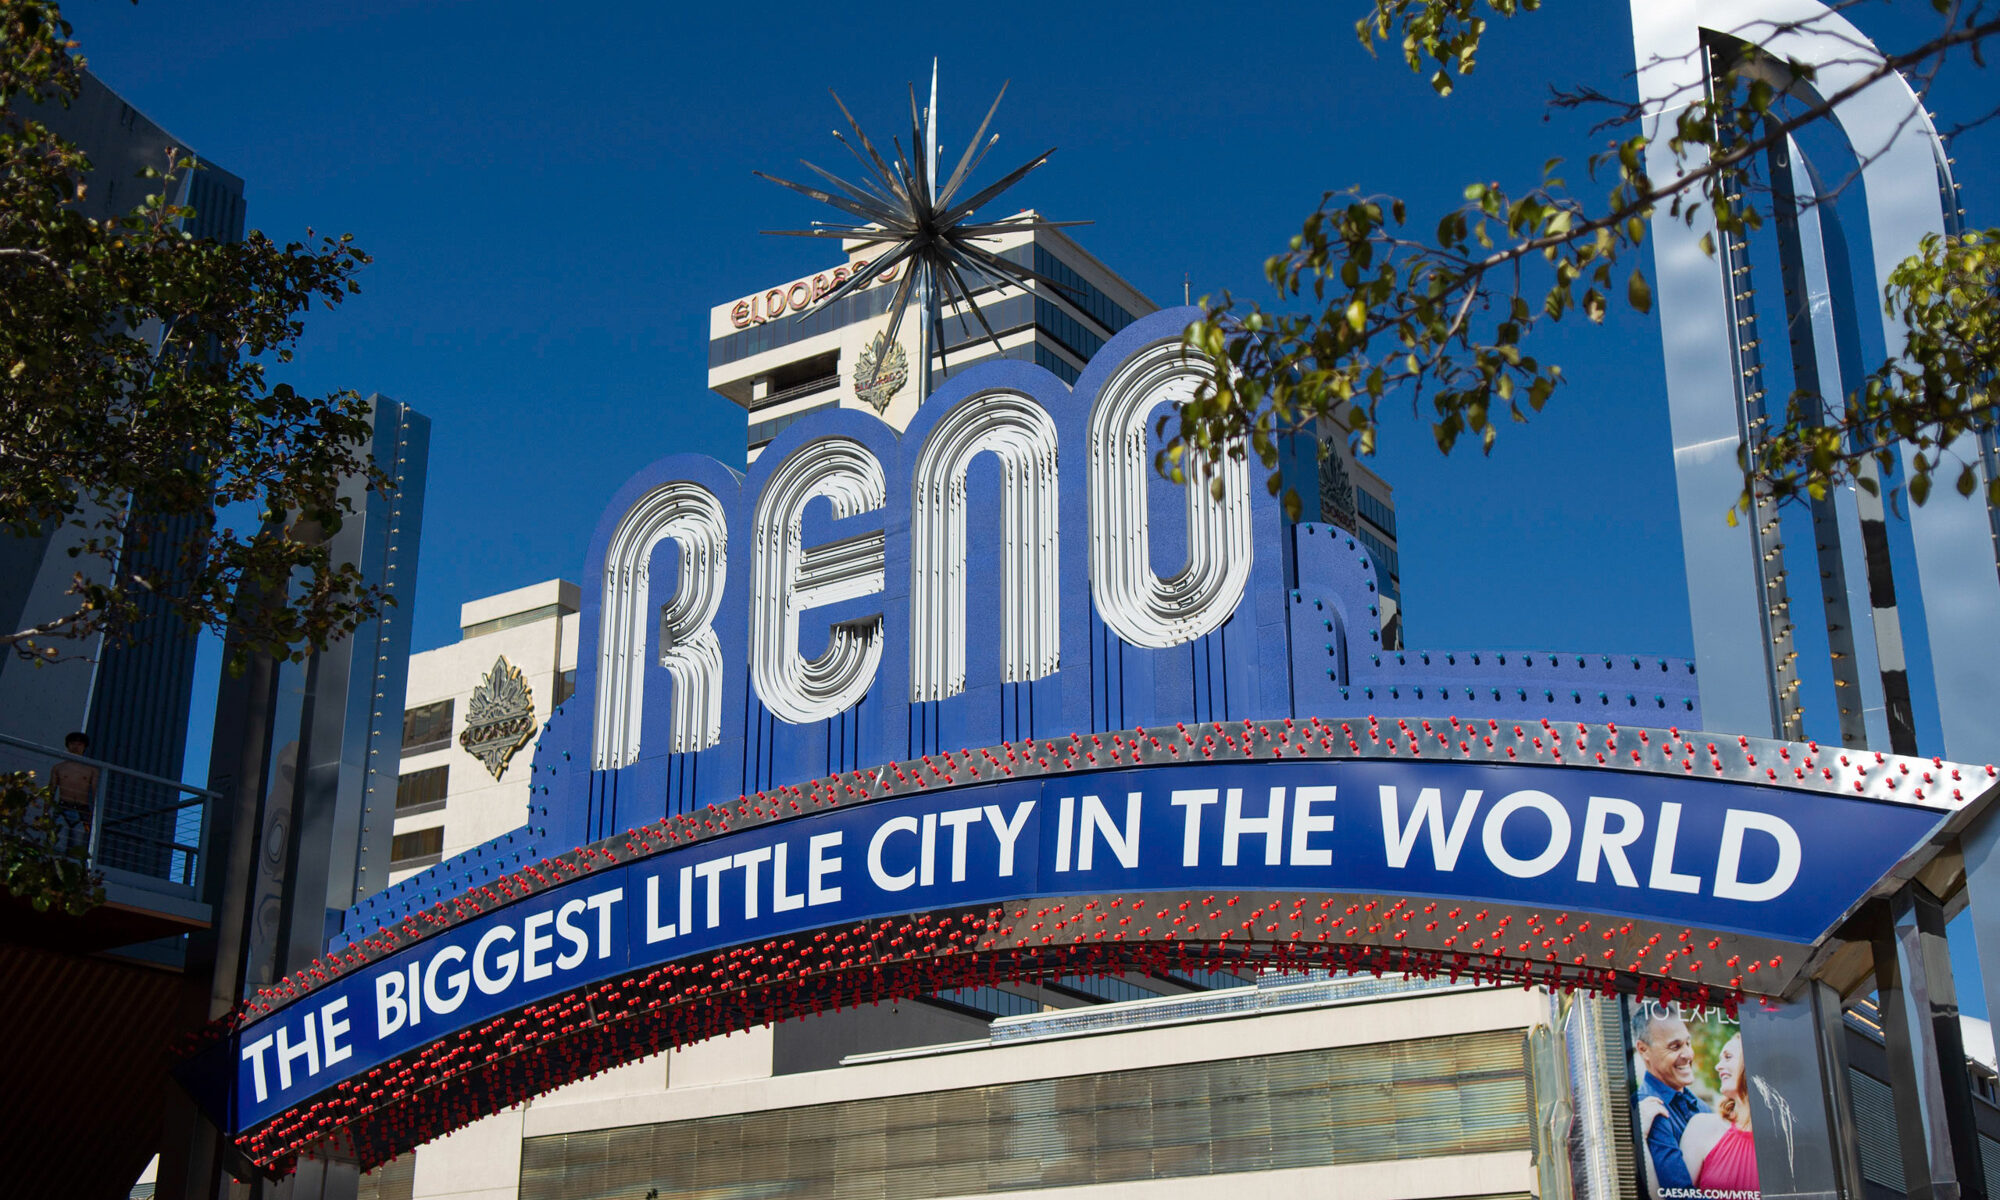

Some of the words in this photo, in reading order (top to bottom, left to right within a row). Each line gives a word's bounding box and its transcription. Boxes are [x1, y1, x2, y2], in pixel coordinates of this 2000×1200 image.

[591, 336, 1254, 771] RENO
[242, 996, 352, 1103] THE
[376, 888, 623, 1040] BIGGEST
[646, 831, 843, 945] LITTLE
[867, 801, 1037, 892] CITY
[1055, 791, 1142, 876] IN
[1170, 785, 1337, 867] THE
[1377, 786, 1802, 902] WORLD
[1641, 1000, 1670, 1021] TO
